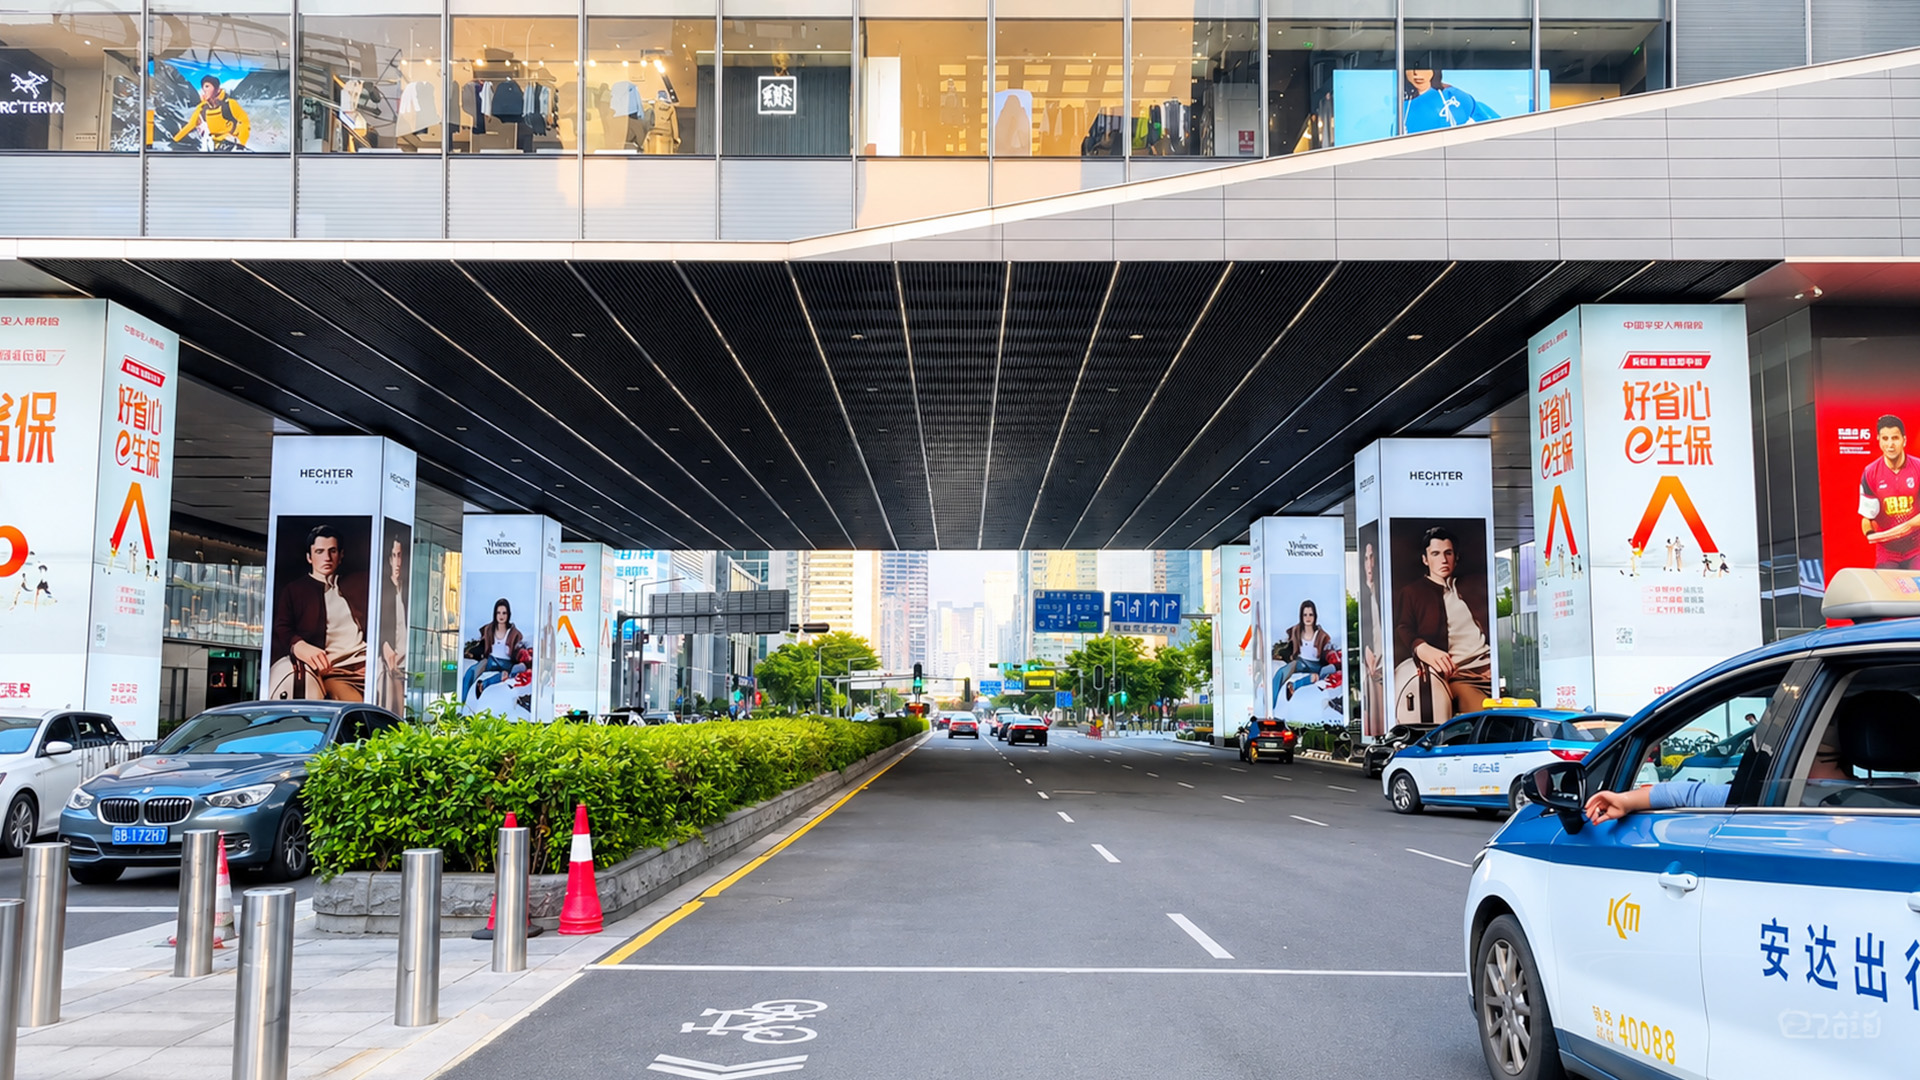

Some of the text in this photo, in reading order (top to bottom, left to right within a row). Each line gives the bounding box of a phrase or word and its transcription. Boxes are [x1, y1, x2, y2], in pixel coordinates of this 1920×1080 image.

[118, 384, 162, 435] 好省心
[1538, 388, 1572, 440] 好省心
[1622, 381, 1711, 421] 好省心
[115, 430, 161, 479] e生保
[1541, 430, 1574, 480] e生保
[1625, 425, 1713, 465] e生保
[300, 469, 353, 478] HECHTER
[1410, 471, 1463, 480] HECHTER
[484, 547, 521, 555] Westwood
[487, 539, 516, 548] Vivienne
[1619, 1014, 1676, 1066] 40088
